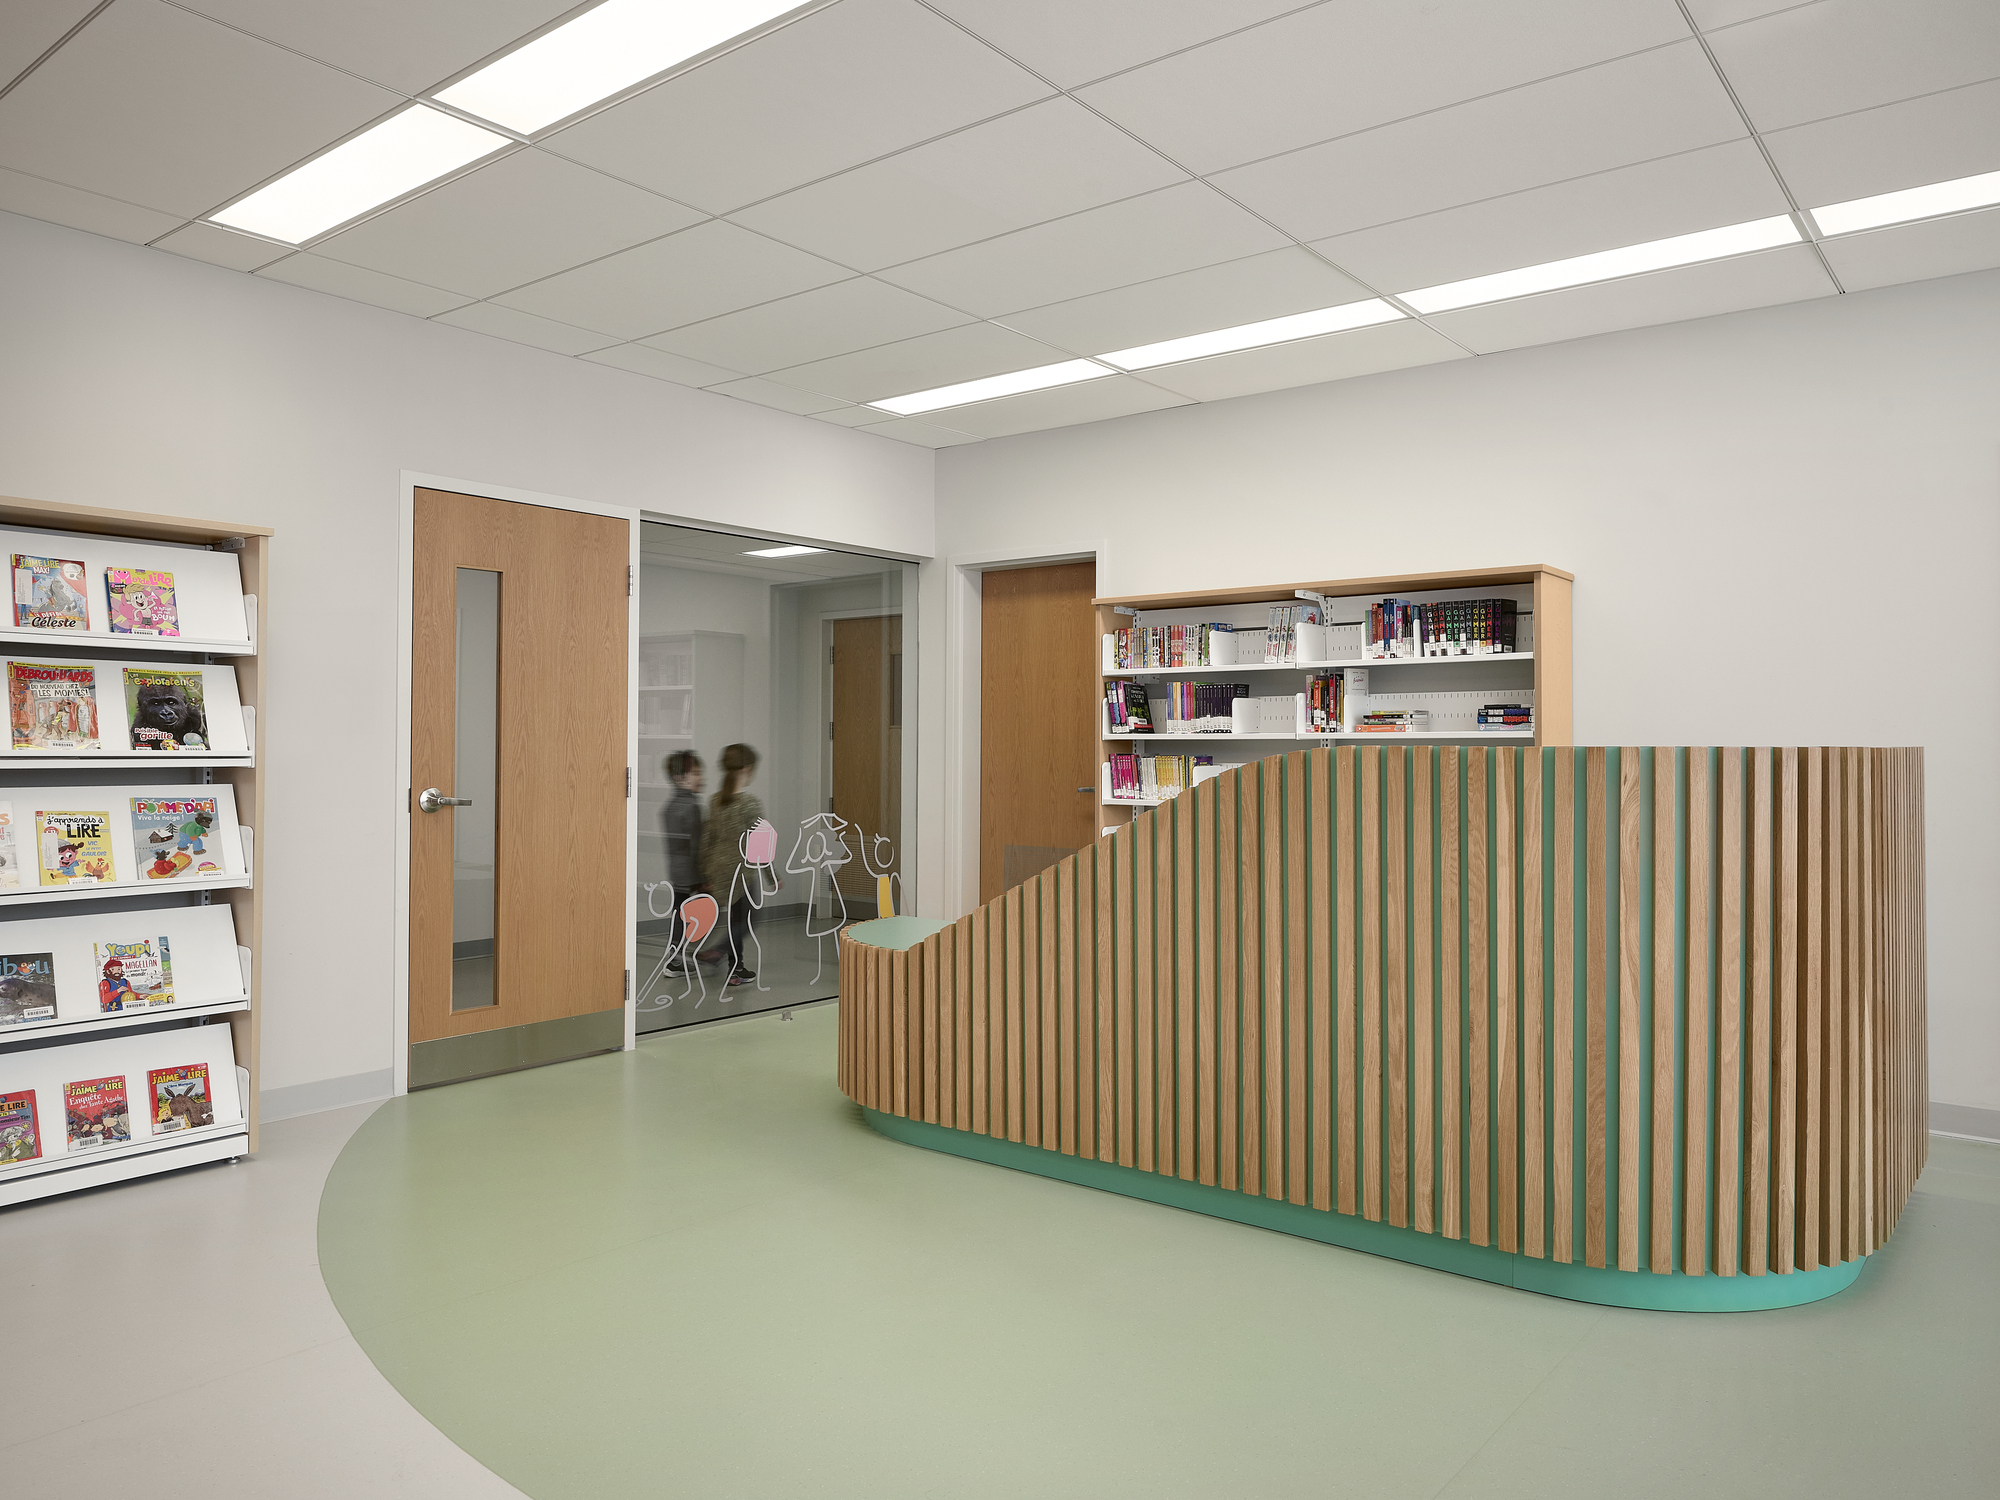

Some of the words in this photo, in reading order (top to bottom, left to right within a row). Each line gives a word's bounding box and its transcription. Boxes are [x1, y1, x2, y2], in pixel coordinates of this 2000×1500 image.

[33, 566, 50, 574] MAX!
[32, 616, 76, 627] Céleste
[140, 732, 173, 740] gorille
[47, 816, 96, 825] j'apprends
[105, 940, 151, 958] Youpi
[125, 959, 158, 970] MAGELLAN
[69, 1093, 102, 1106] Enquête
[88, 1100, 103, 1108] Tante
[8, 1101, 26, 1110] LIRE
